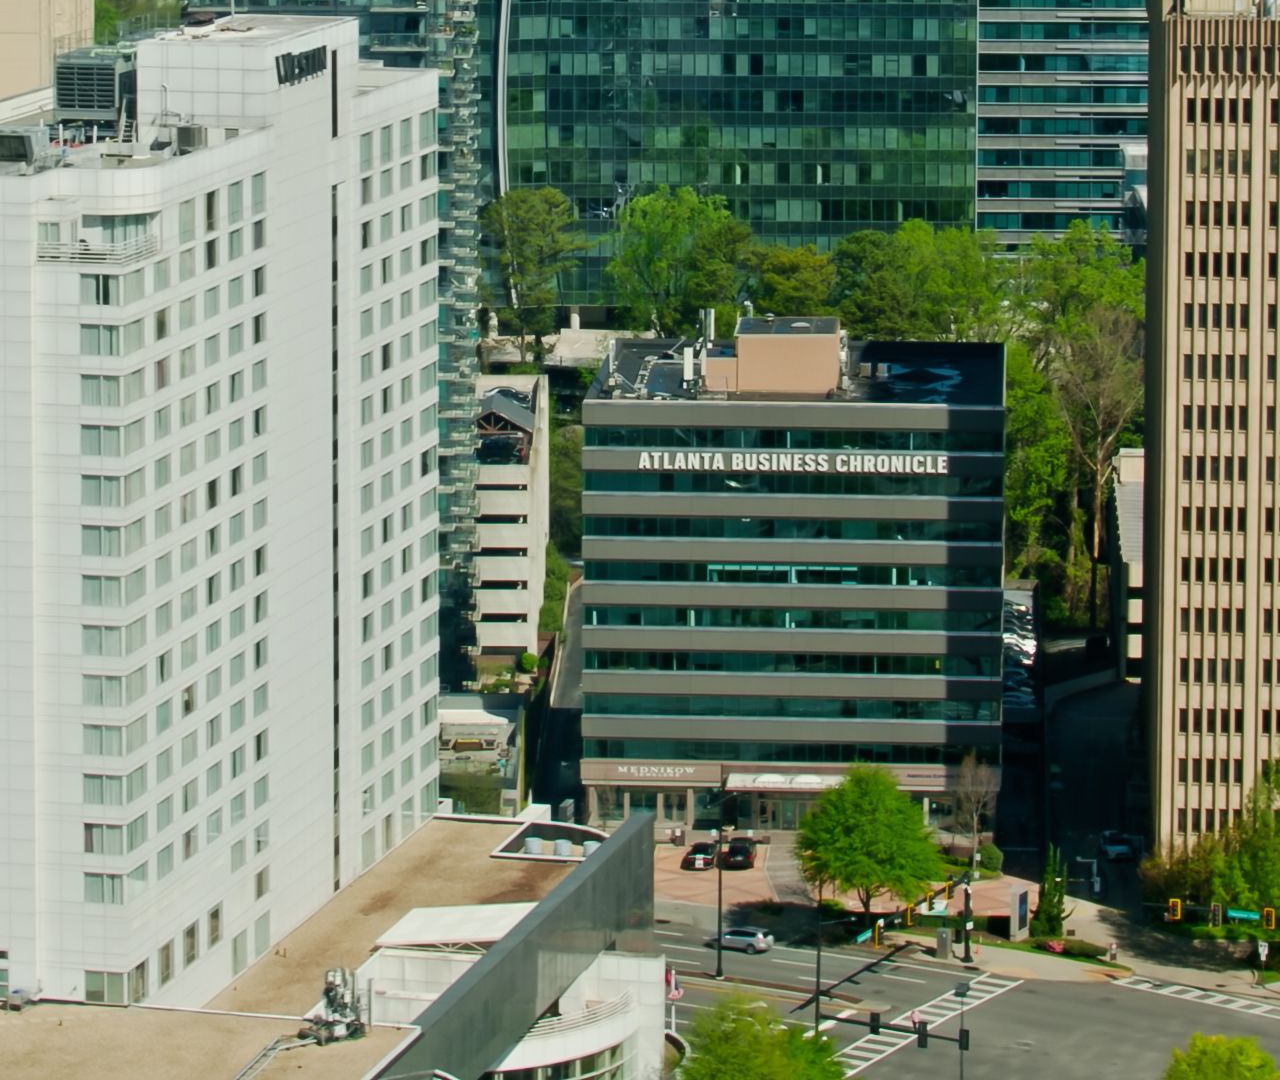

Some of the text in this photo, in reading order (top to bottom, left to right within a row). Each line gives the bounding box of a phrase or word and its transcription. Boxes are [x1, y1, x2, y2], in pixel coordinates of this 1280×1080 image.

[638, 451, 949, 474] ATLANTA BUSINESS CHRONICLE
[618, 766, 696, 774] MEDNIKOW
